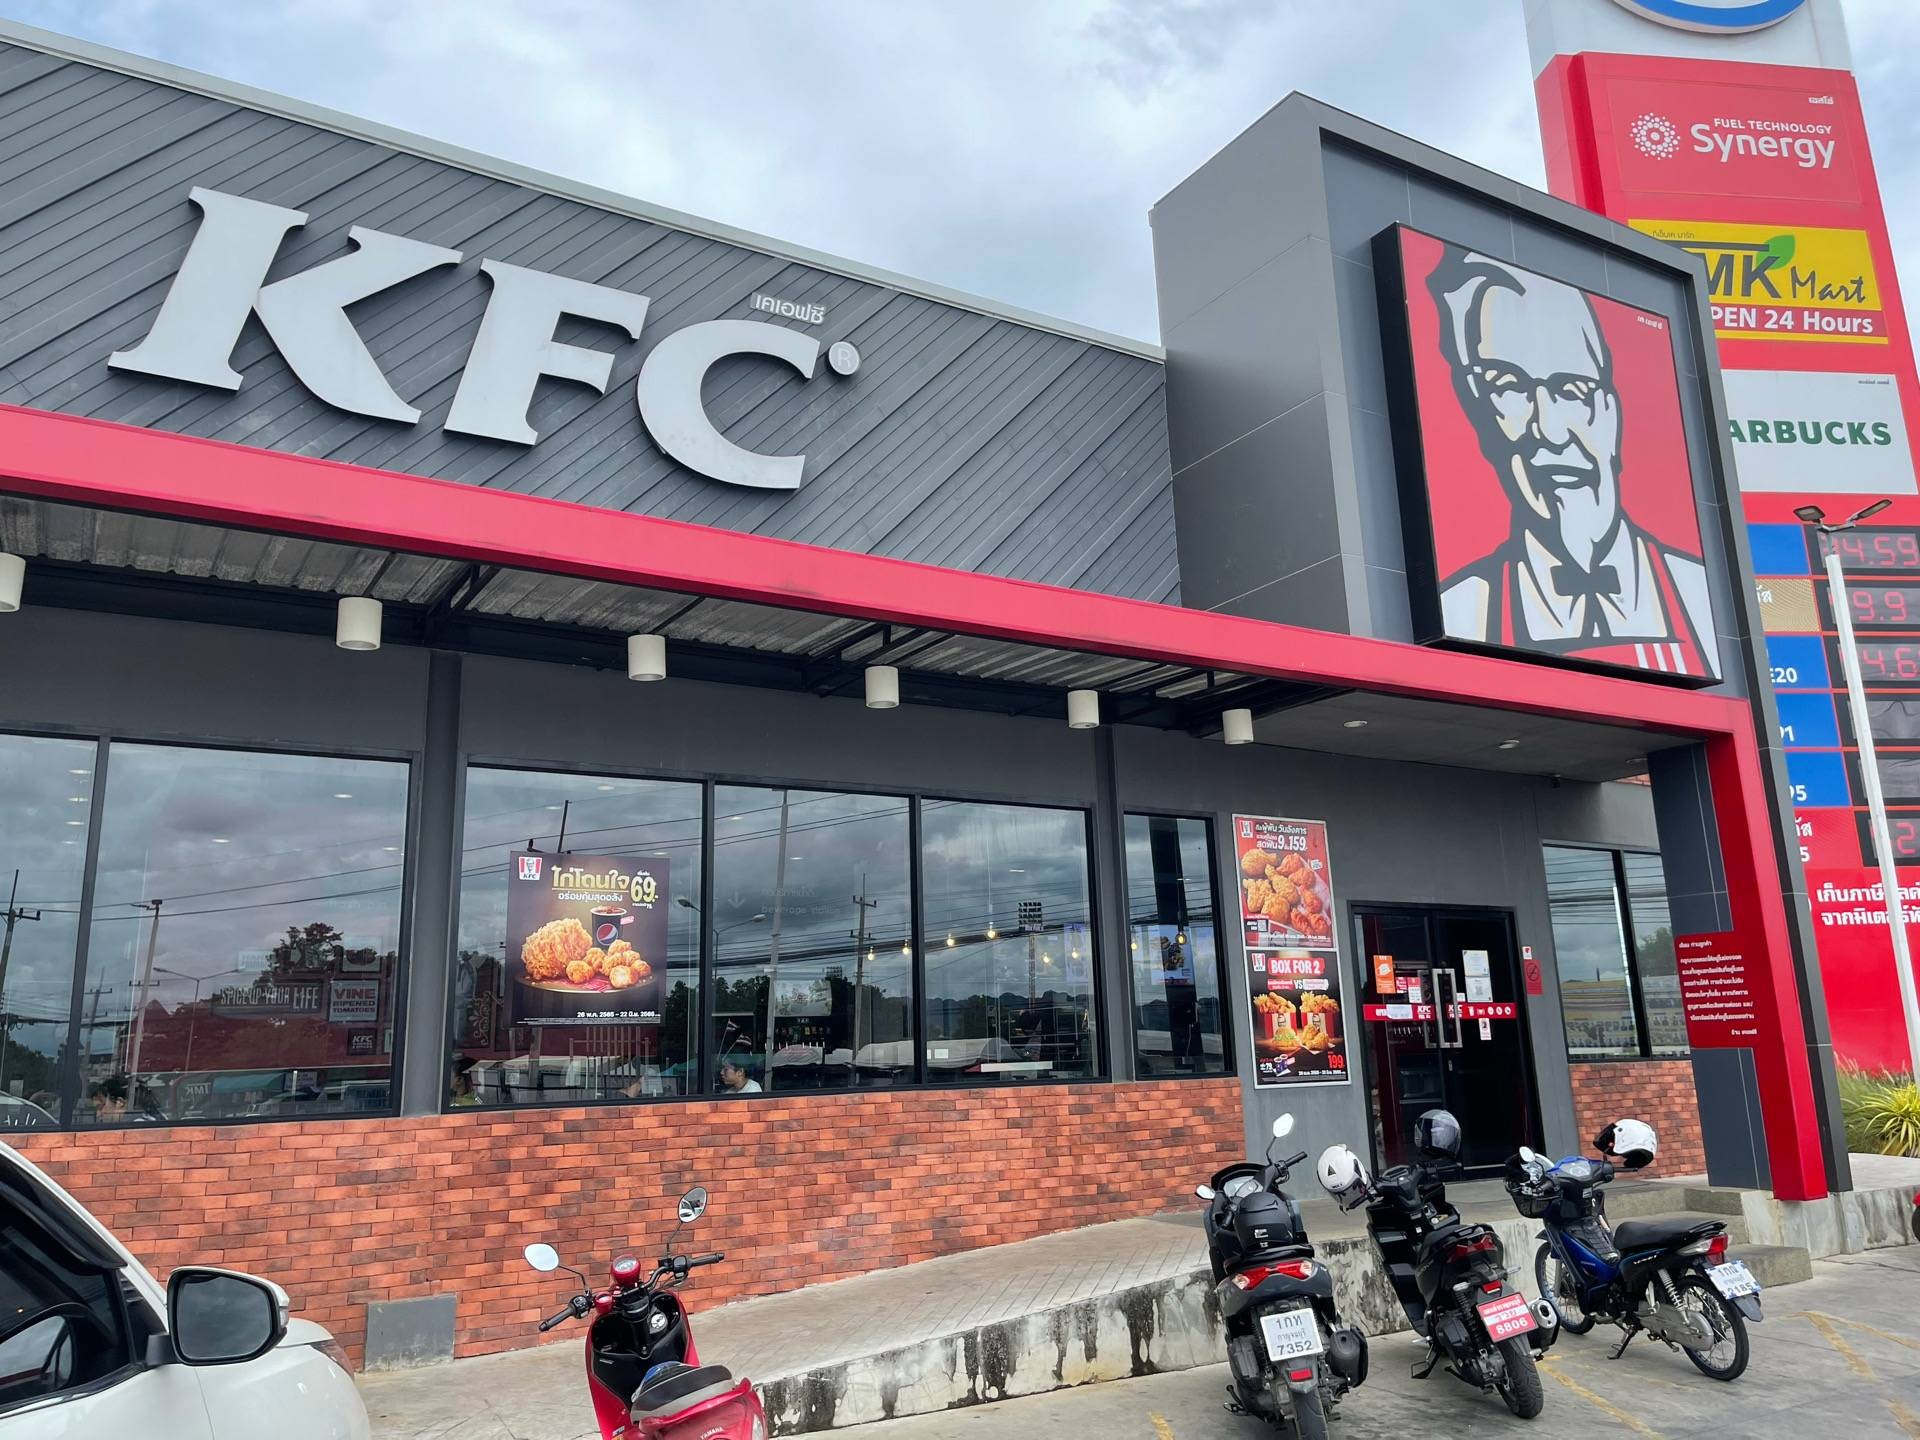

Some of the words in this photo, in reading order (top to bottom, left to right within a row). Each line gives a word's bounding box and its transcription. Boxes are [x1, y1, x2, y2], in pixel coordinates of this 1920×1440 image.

[1714, 118, 1746, 129] FUEL
[1748, 120, 1832, 134] TECHNOLOGY
[1690, 123, 1835, 168] Synergy
[1693, 248, 1782, 299] MK
[1790, 266, 1866, 304] Mart
[1764, 309, 1794, 330] 24
[1803, 311, 1874, 333] Hours
[108, 187, 820, 490] KFC
[1278, 834, 1285, 850] 9
[551, 864, 630, 890] ไก่โดนใจ
[1271, 959, 1291, 974] BOX
[1293, 960, 1312, 974] FOR
[1313, 960, 1320, 974] 2
[334, 988, 376, 1000] VINE
[1496, 1317, 1528, 1334] 8806
[1277, 1340, 1312, 1355] 7352
[700, 1426, 724, 1439] YAMAHA
